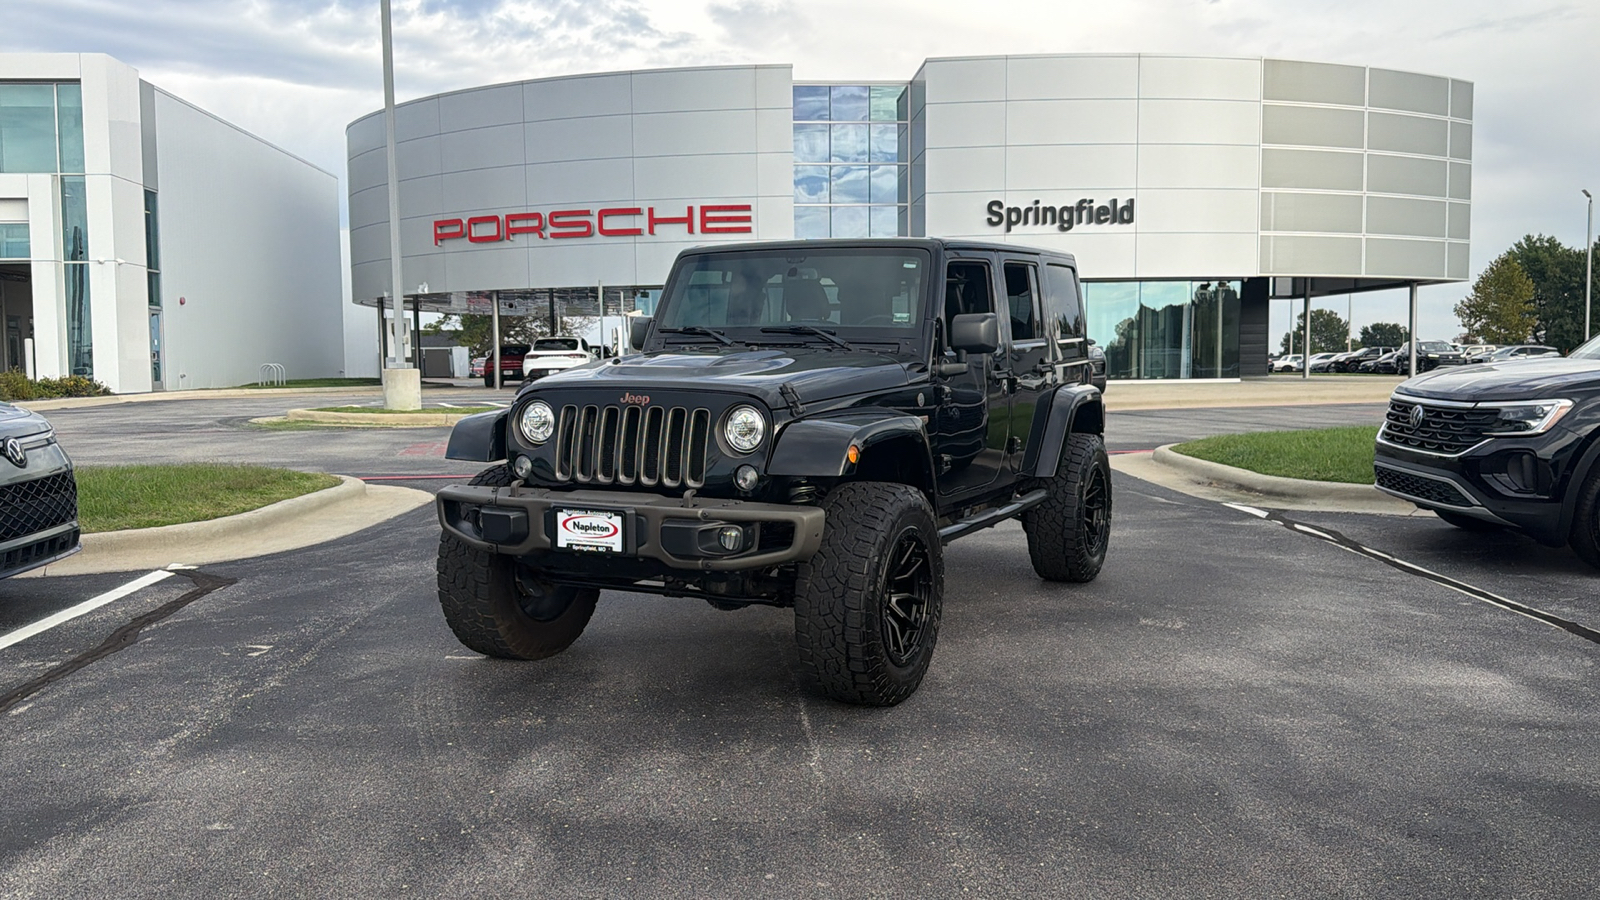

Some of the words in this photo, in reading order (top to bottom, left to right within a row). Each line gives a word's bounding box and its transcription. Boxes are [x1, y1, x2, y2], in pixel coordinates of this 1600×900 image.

[433, 204, 752, 246] PORSCHE
[987, 198, 1134, 233] Springfield
[620, 392, 650, 406] Jeep
[573, 521, 610, 532] Napleton
